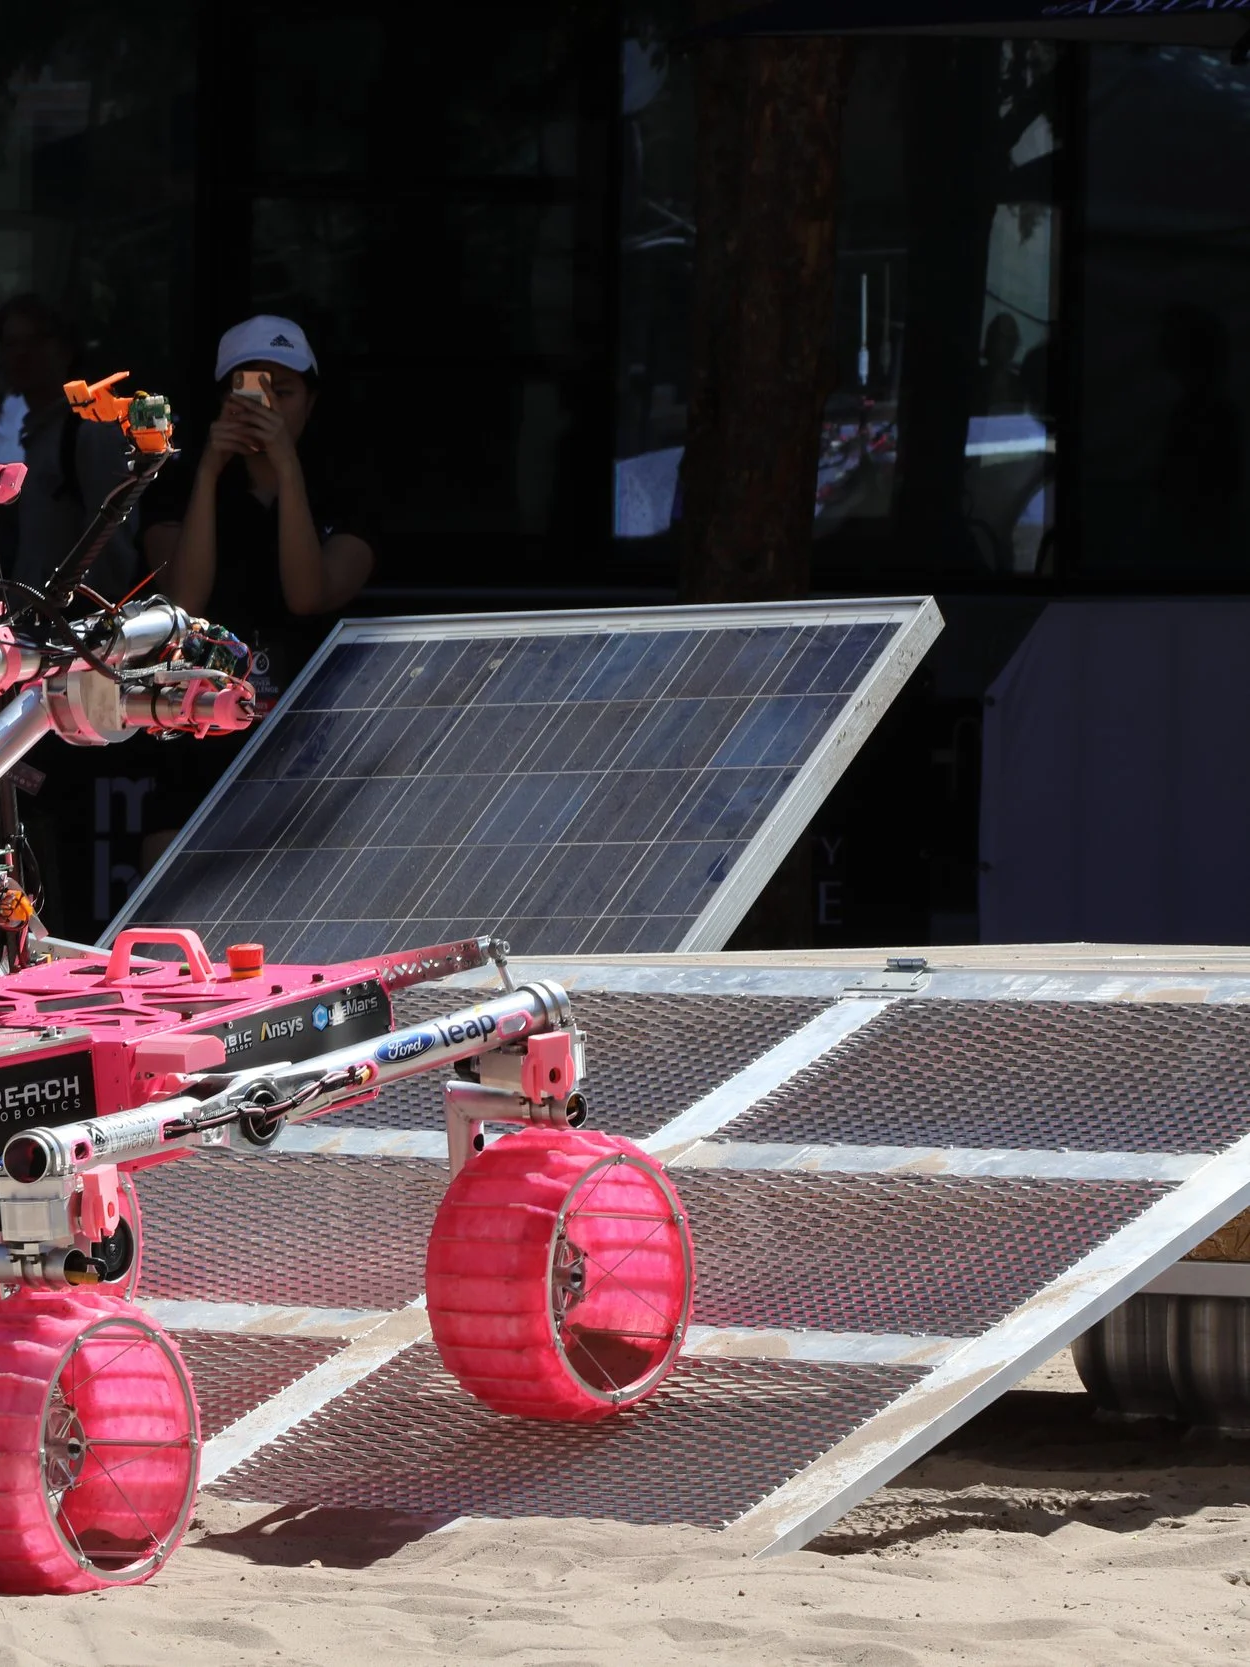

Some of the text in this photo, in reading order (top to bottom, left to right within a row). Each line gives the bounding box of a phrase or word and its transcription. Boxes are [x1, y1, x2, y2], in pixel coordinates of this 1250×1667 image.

[224, 1030, 252, 1048] BIC
[260, 1017, 304, 1042] Ansys
[388, 1014, 496, 1060] Ford leap
